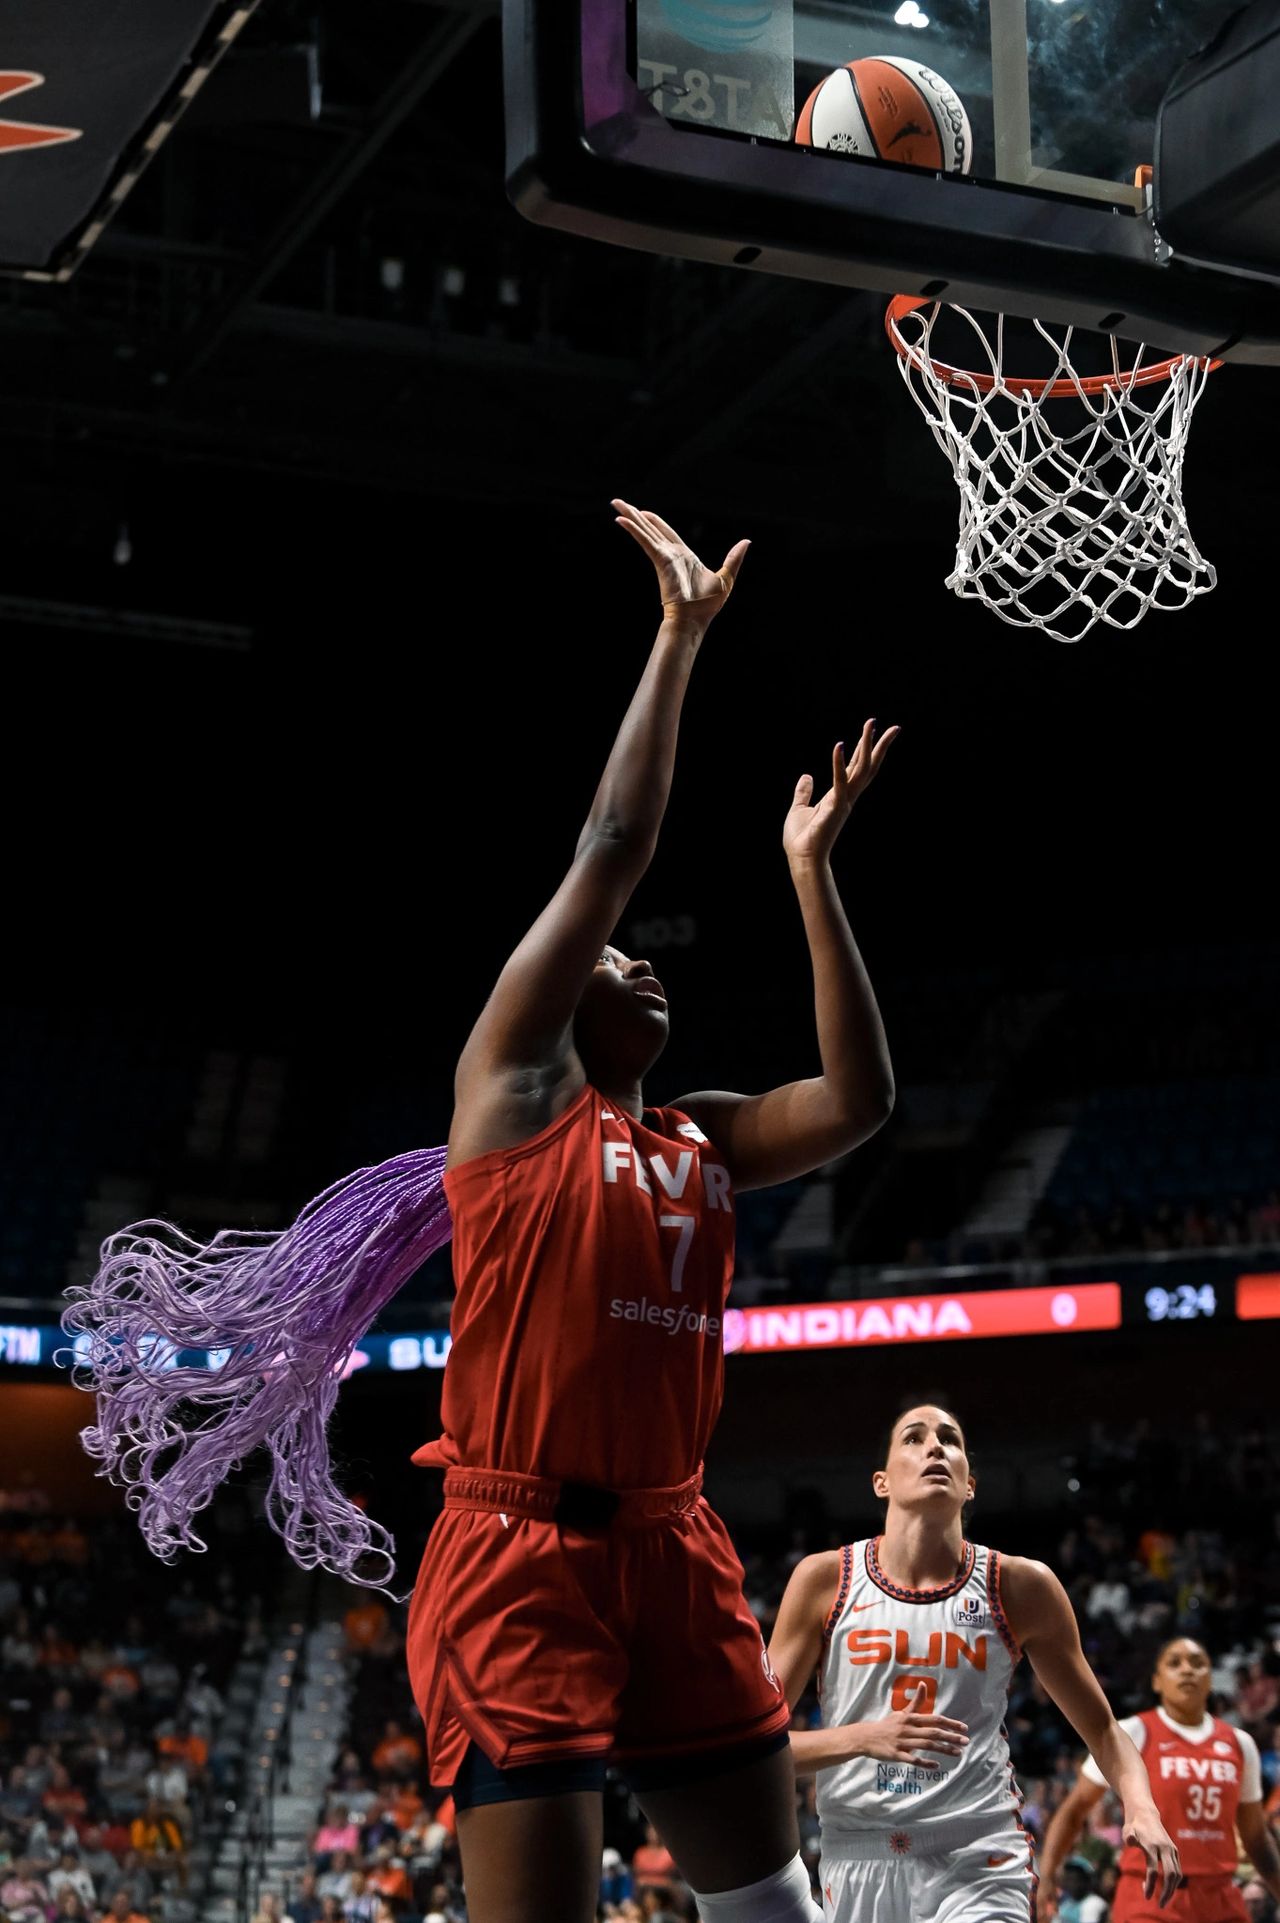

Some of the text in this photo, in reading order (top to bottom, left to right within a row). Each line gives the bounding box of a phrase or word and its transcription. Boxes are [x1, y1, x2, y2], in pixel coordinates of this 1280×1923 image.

[602, 1142, 732, 1213] FEVR
[660, 1215, 695, 1292] 7
[1145, 1284, 1217, 1322] 9:24
[750, 1300, 973, 1346] INDIANA
[389, 1336, 453, 1371] SU
[958, 1612, 983, 1623] Post
[847, 1629, 987, 1672] SUN
[877, 1763, 949, 1782] NewHaven
[877, 1779, 922, 1795] Health
[1160, 1756, 1238, 1783] FEVER
[1187, 1784, 1223, 1821] 35
